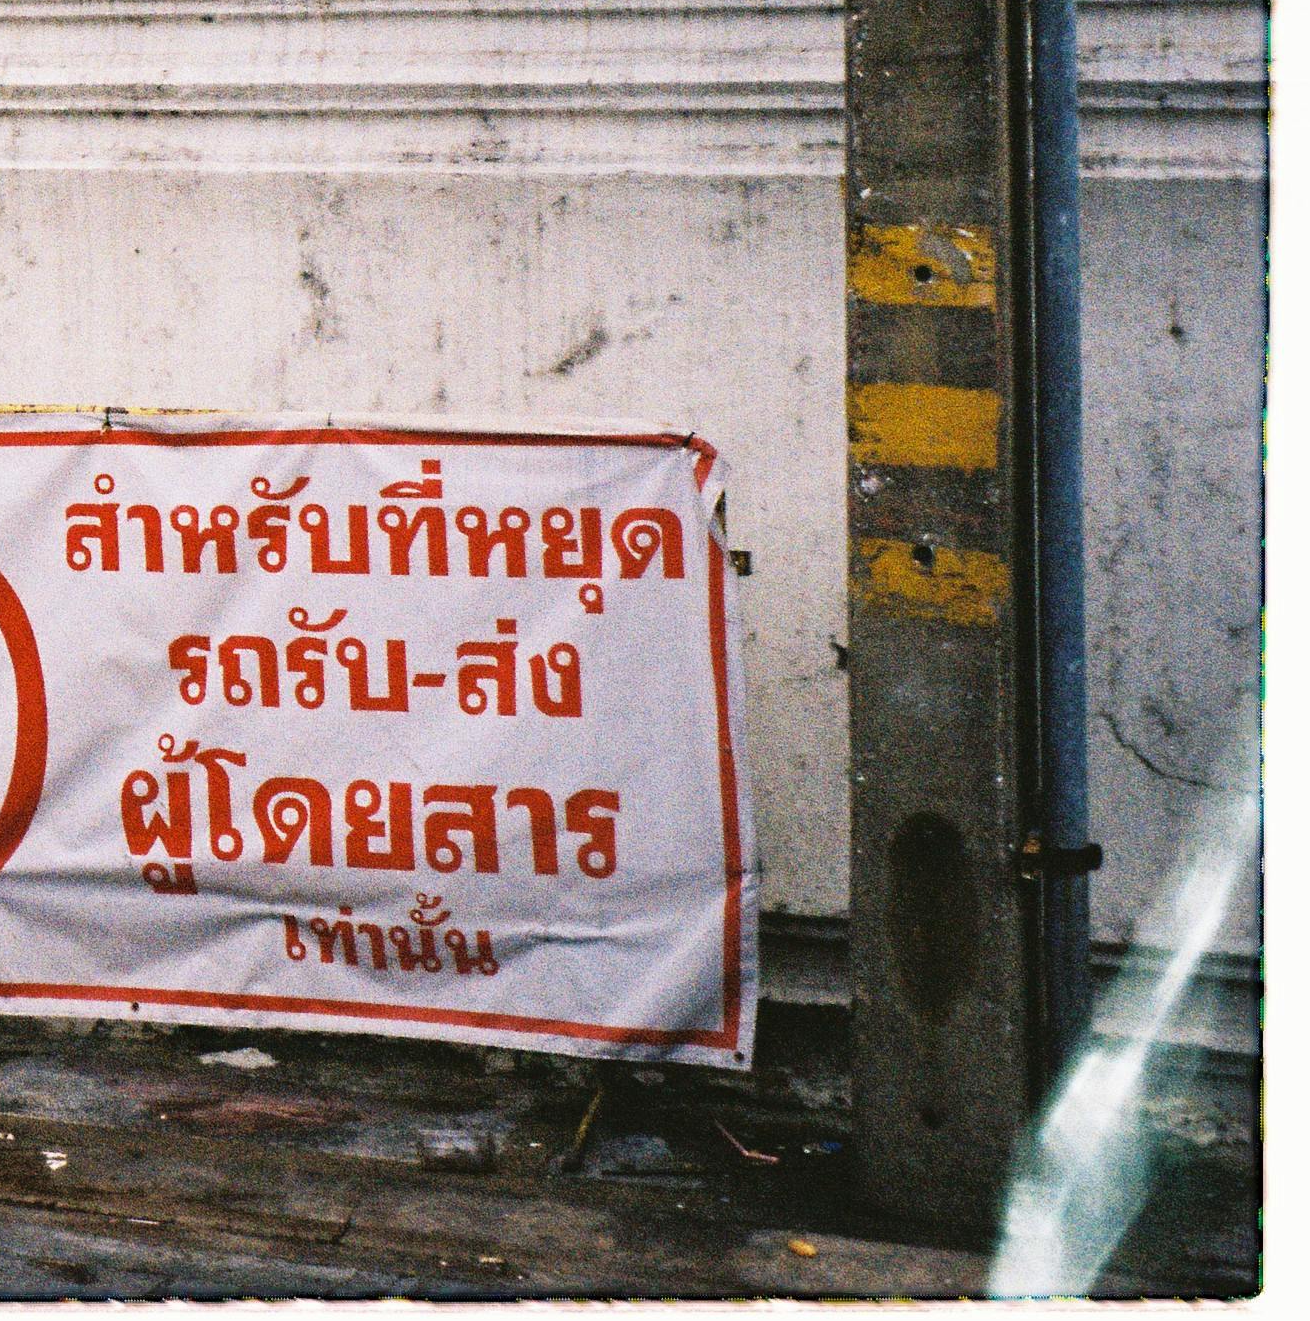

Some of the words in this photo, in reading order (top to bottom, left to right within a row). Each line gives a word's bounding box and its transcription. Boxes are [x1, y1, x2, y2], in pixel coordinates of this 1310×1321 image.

[64, 459, 686, 615] สำหรับที่หยุด
[167, 606, 583, 719] รถรับ-ส่ง
[119, 733, 621, 896] ผู้โดยสาร
[283, 892, 500, 977] เท่านั้น
